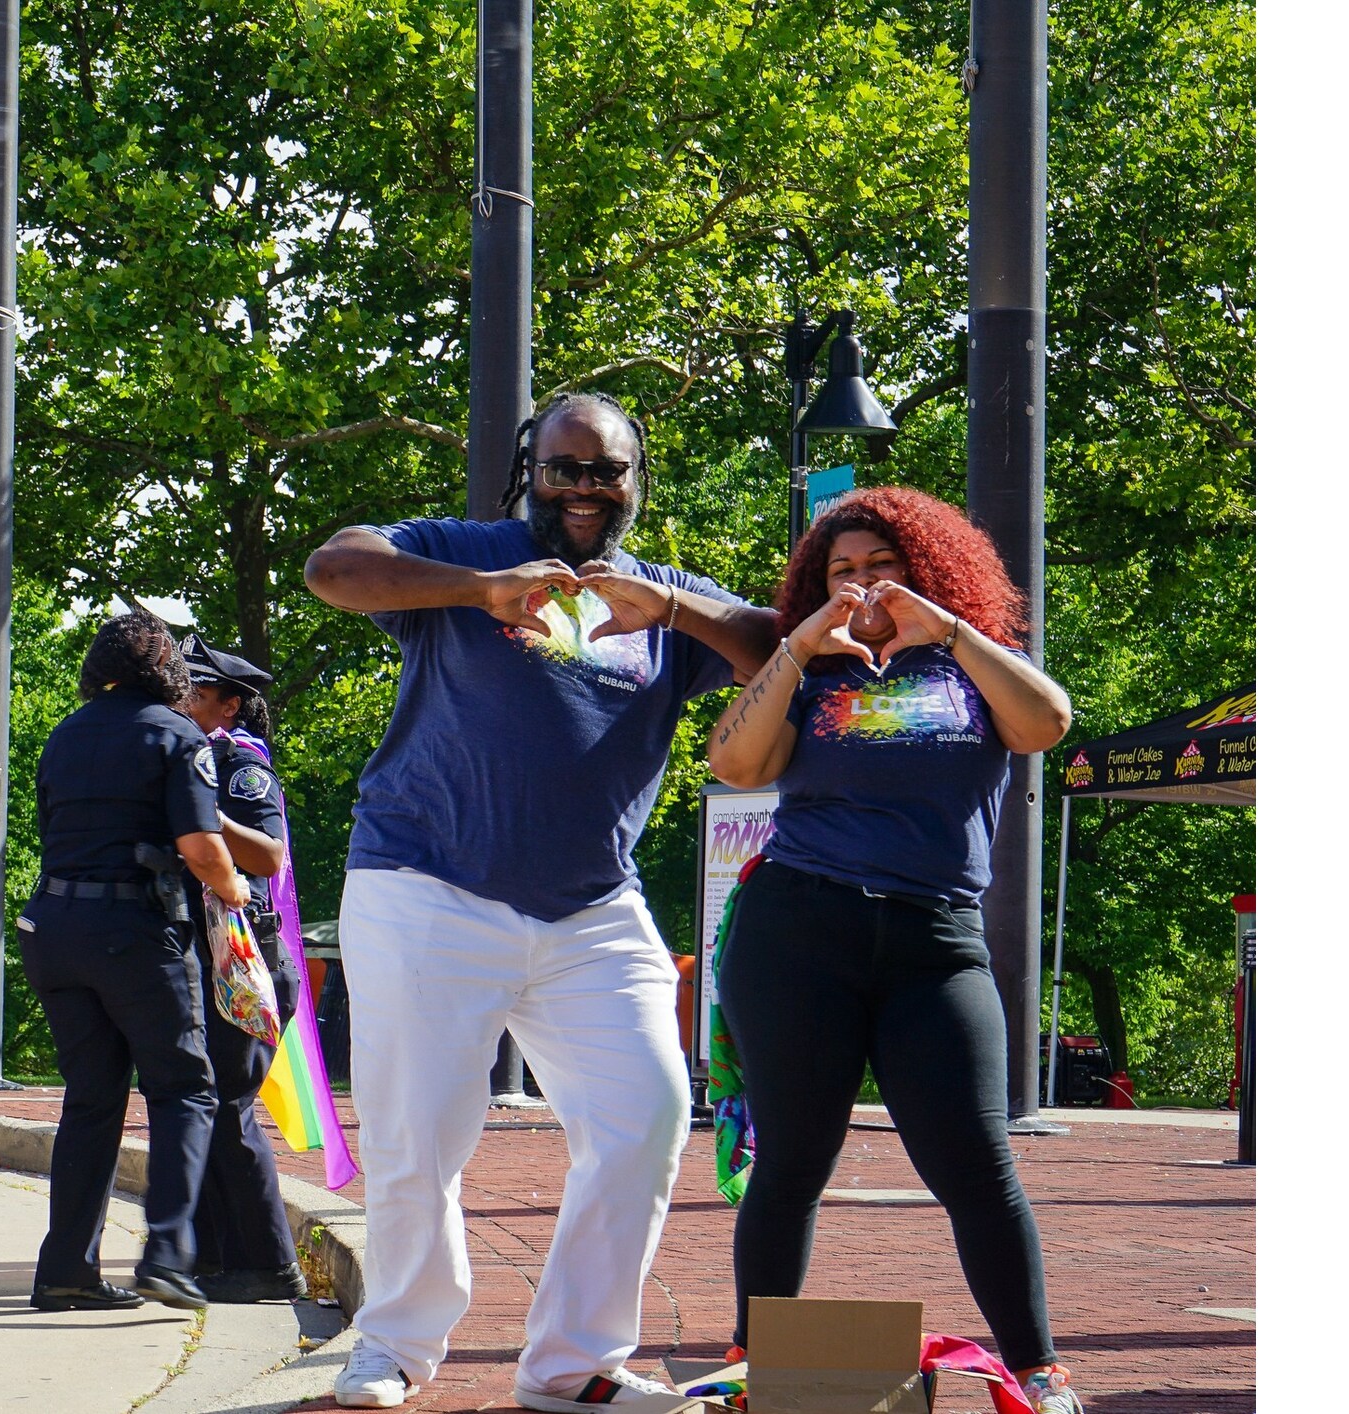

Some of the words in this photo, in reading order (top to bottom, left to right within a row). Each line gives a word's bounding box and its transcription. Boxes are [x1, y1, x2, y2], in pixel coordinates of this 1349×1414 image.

[597, 674, 637, 692] SUBARU
[936, 733, 982, 744] SUBARU
[1219, 736, 1248, 753] Funnel
[1107, 748, 1137, 765] Funnel
[1137, 747, 1164, 763] Cakes
[1217, 760, 1225, 774] &
[1227, 756, 1256, 773] Water
[1107, 770, 1115, 784] &
[1117, 767, 1145, 783] Water
[1145, 765, 1162, 781] Ice
